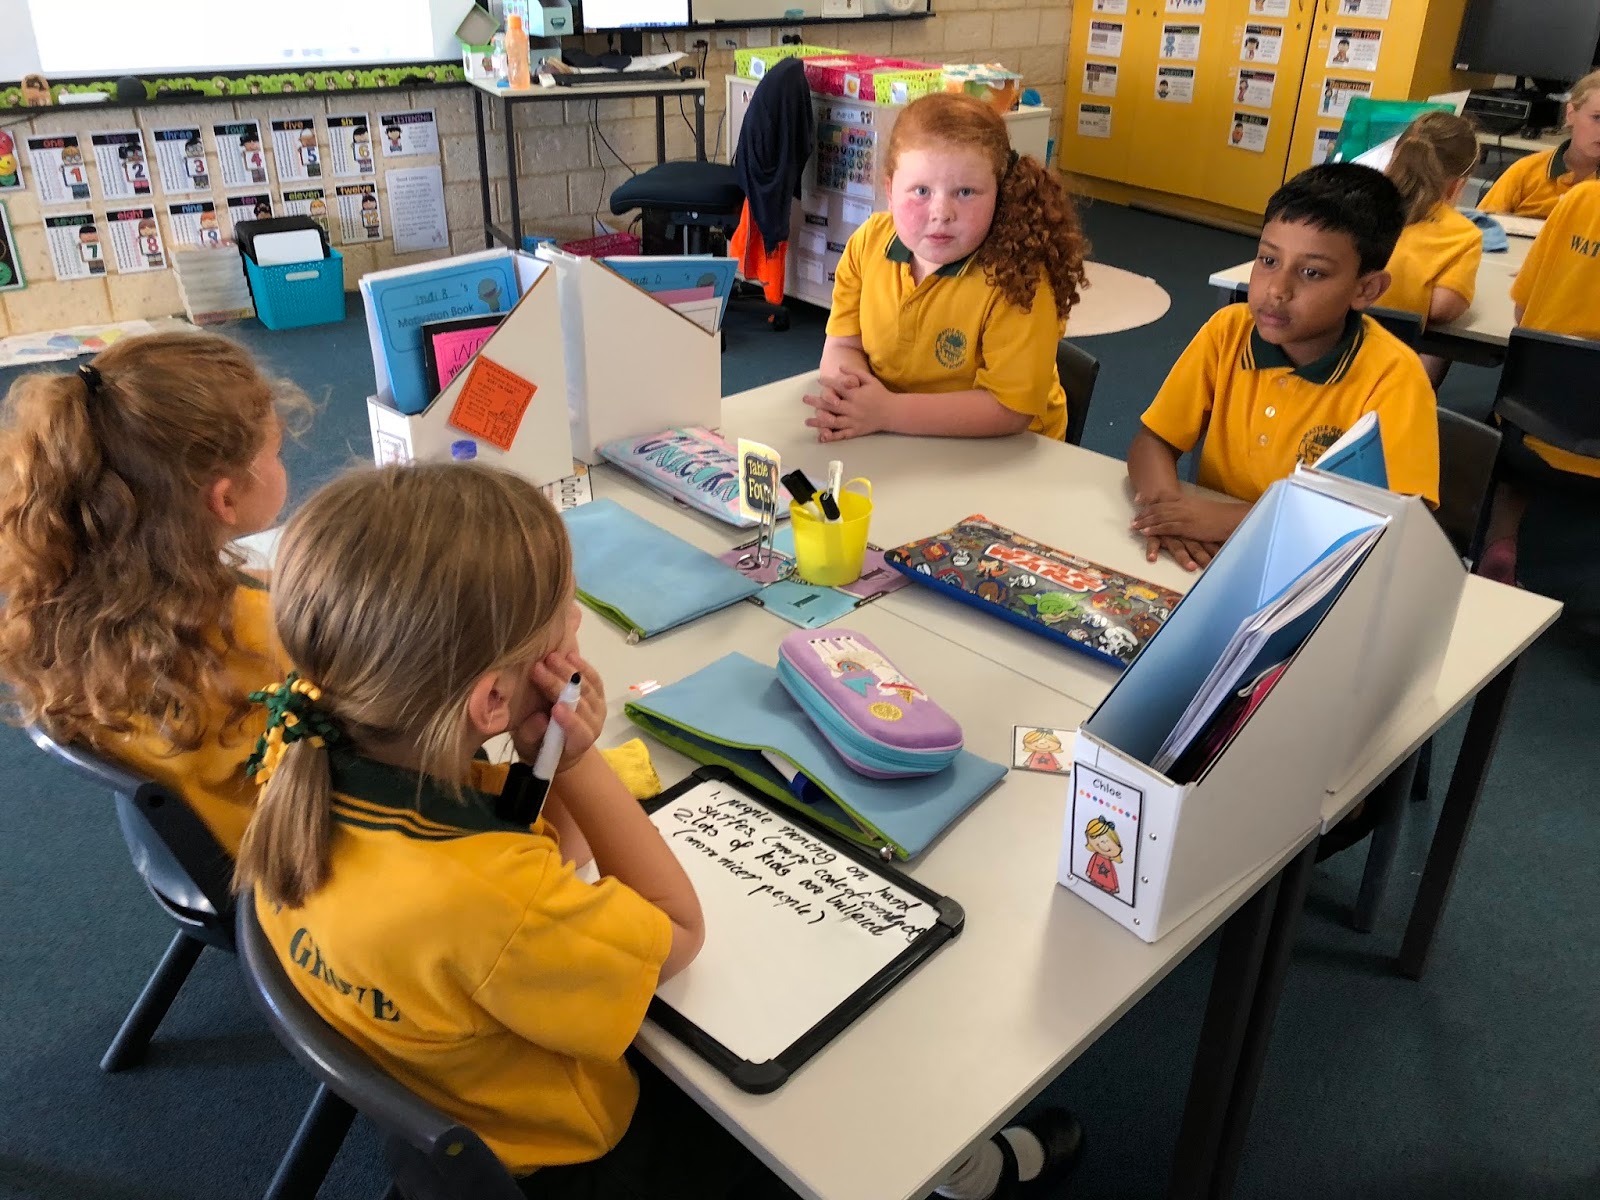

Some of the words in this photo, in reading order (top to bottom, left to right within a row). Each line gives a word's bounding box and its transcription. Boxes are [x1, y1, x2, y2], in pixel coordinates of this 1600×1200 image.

[283, 120, 304, 130] five
[340, 117, 354, 126] six
[392, 113, 431, 124] LISTENING
[163, 130, 193, 140] three
[224, 125, 247, 135] four
[42, 139, 65, 148] one
[105, 134, 128, 144] two
[307, 149, 317, 163] 5
[358, 144, 370, 158] 6
[193, 159, 205, 173] 3
[250, 152, 262, 167] 4
[70, 166, 82, 182] 1
[132, 163, 146, 178] 2
[288, 190, 320, 200] eleven
[339, 185, 372, 195] twelve
[240, 196, 258, 205] ten
[116, 208, 144, 221] eight
[181, 204, 204, 213] nine
[54, 216, 88, 226] seven
[364, 210, 380, 225] 12
[207, 231, 218, 242] 9
[146, 235, 159, 253] 8
[86, 244, 98, 259] 7
[397, 309, 450, 328] Motivation
[450, 303, 475, 317] Book
[633, 440, 740, 502] UNICORN
[747, 459, 769, 478] Table
[1092, 778, 1122, 800] Chloe
[716, 799, 773, 824] people
[846, 866, 869, 881] on
[874, 886, 922, 913] hard
[717, 857, 762, 881] nicer
[729, 839, 754, 853] of
[754, 849, 796, 877] kids
[798, 879, 824, 895] are
